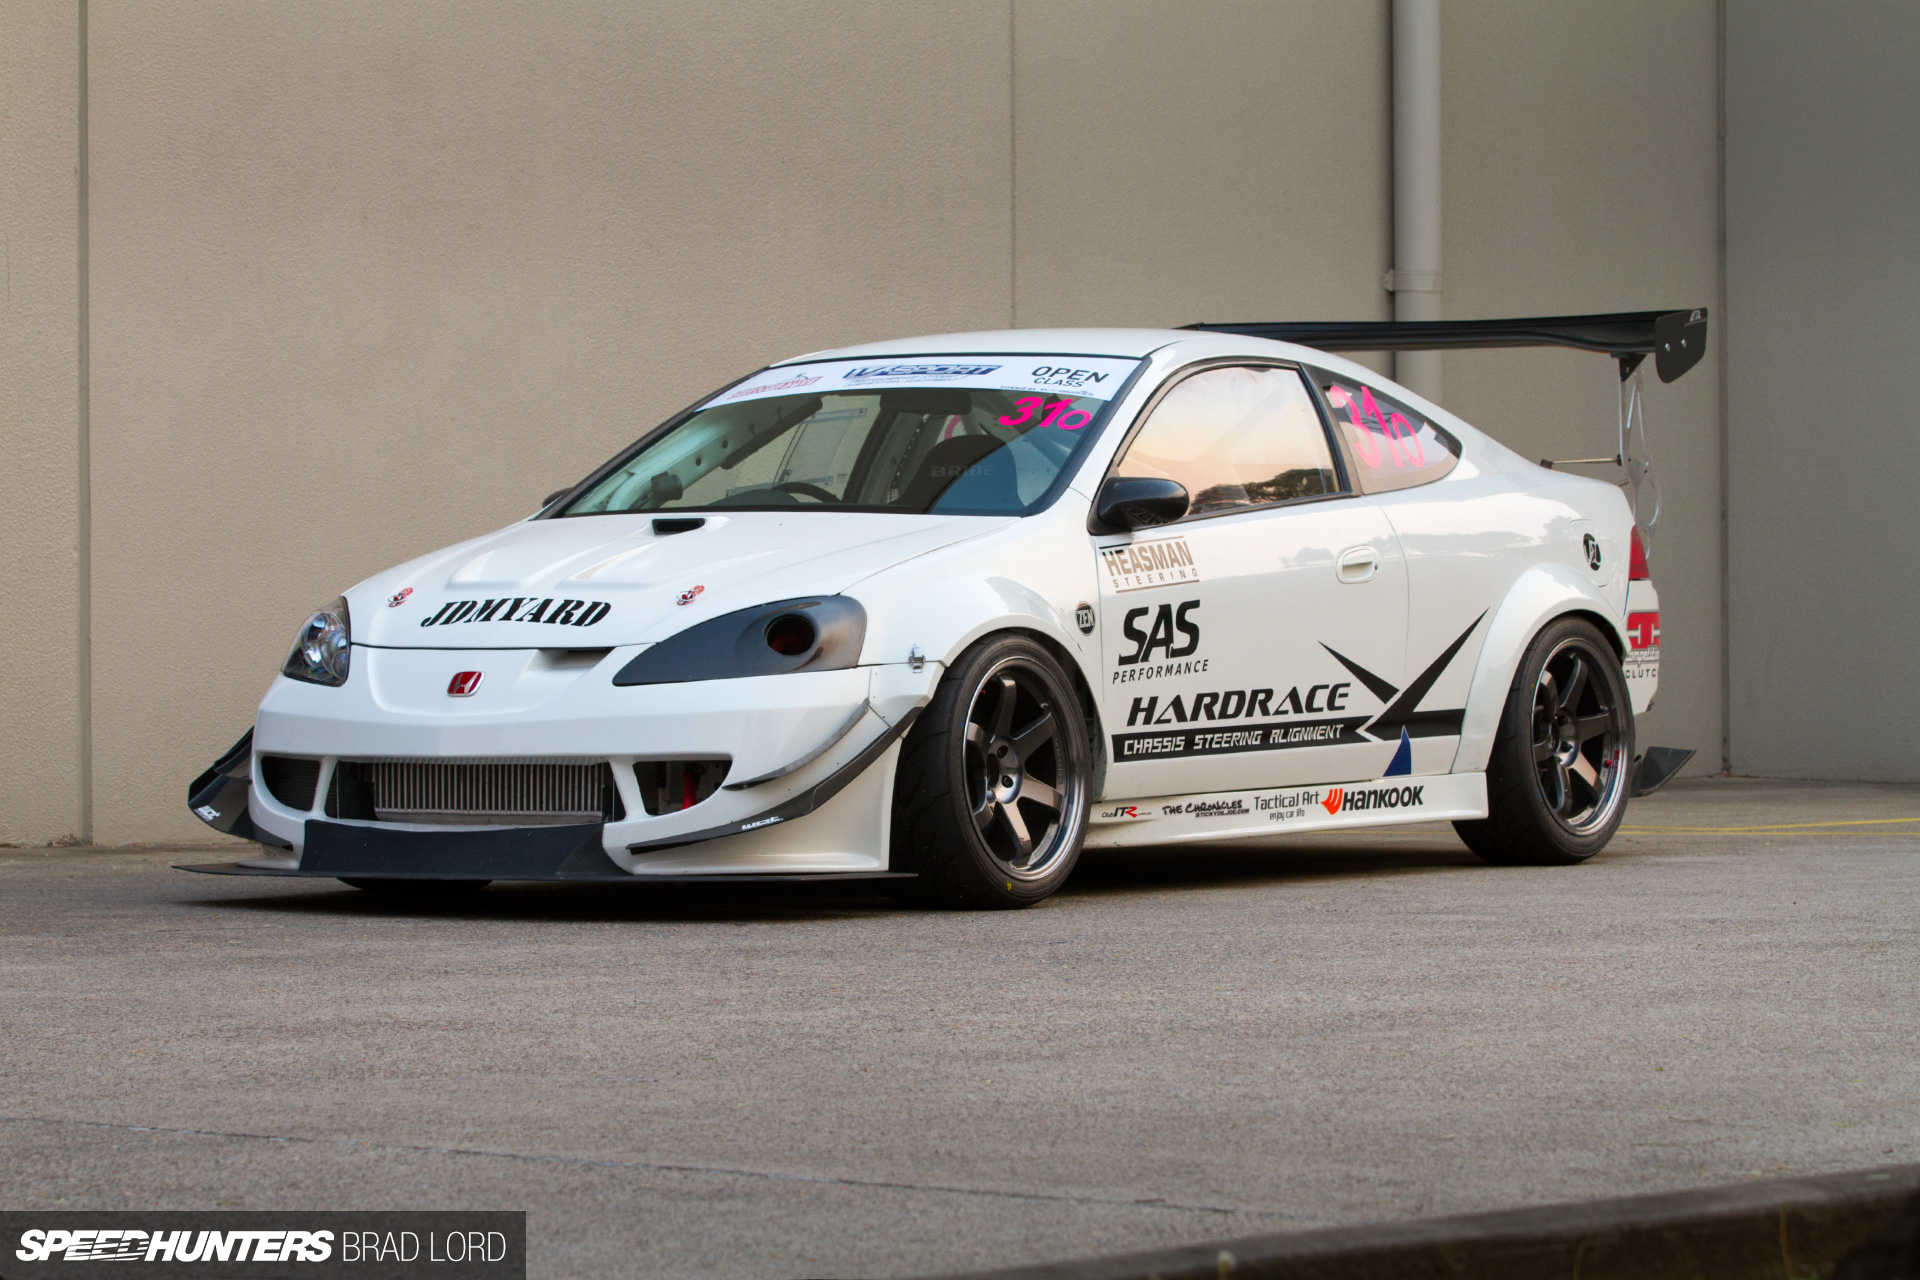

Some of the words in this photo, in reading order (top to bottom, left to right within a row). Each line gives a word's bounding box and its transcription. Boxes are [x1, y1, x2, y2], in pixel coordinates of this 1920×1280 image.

[1031, 366, 1110, 383] OPEN
[1033, 377, 1085, 388] CLASS
[999, 396, 1092, 430] 310
[1329, 386, 1425, 469] 310
[1102, 540, 1194, 577] HEASMAN
[1113, 568, 1198, 588] STEERING
[421, 597, 611, 627] JDMYARD
[1077, 609, 1094, 628] ZEN
[1118, 599, 1201, 666] SAS
[1112, 659, 1209, 684] PERFORMANCE
[1126, 683, 1351, 726] HARDRACE
[1124, 736, 1185, 755] CHASSIS
[1193, 731, 1262, 750] STEERING
[1269, 724, 1344, 744] ALIGNMENT
[1162, 805, 1183, 816] THE
[1185, 800, 1243, 814] CHRONICLES
[1253, 790, 1300, 811] Tactical
[1302, 790, 1320, 805] Art
[1269, 811, 1285, 821] enjoy
[1286, 809, 1295, 819] car
[1296, 808, 1305, 818] life
